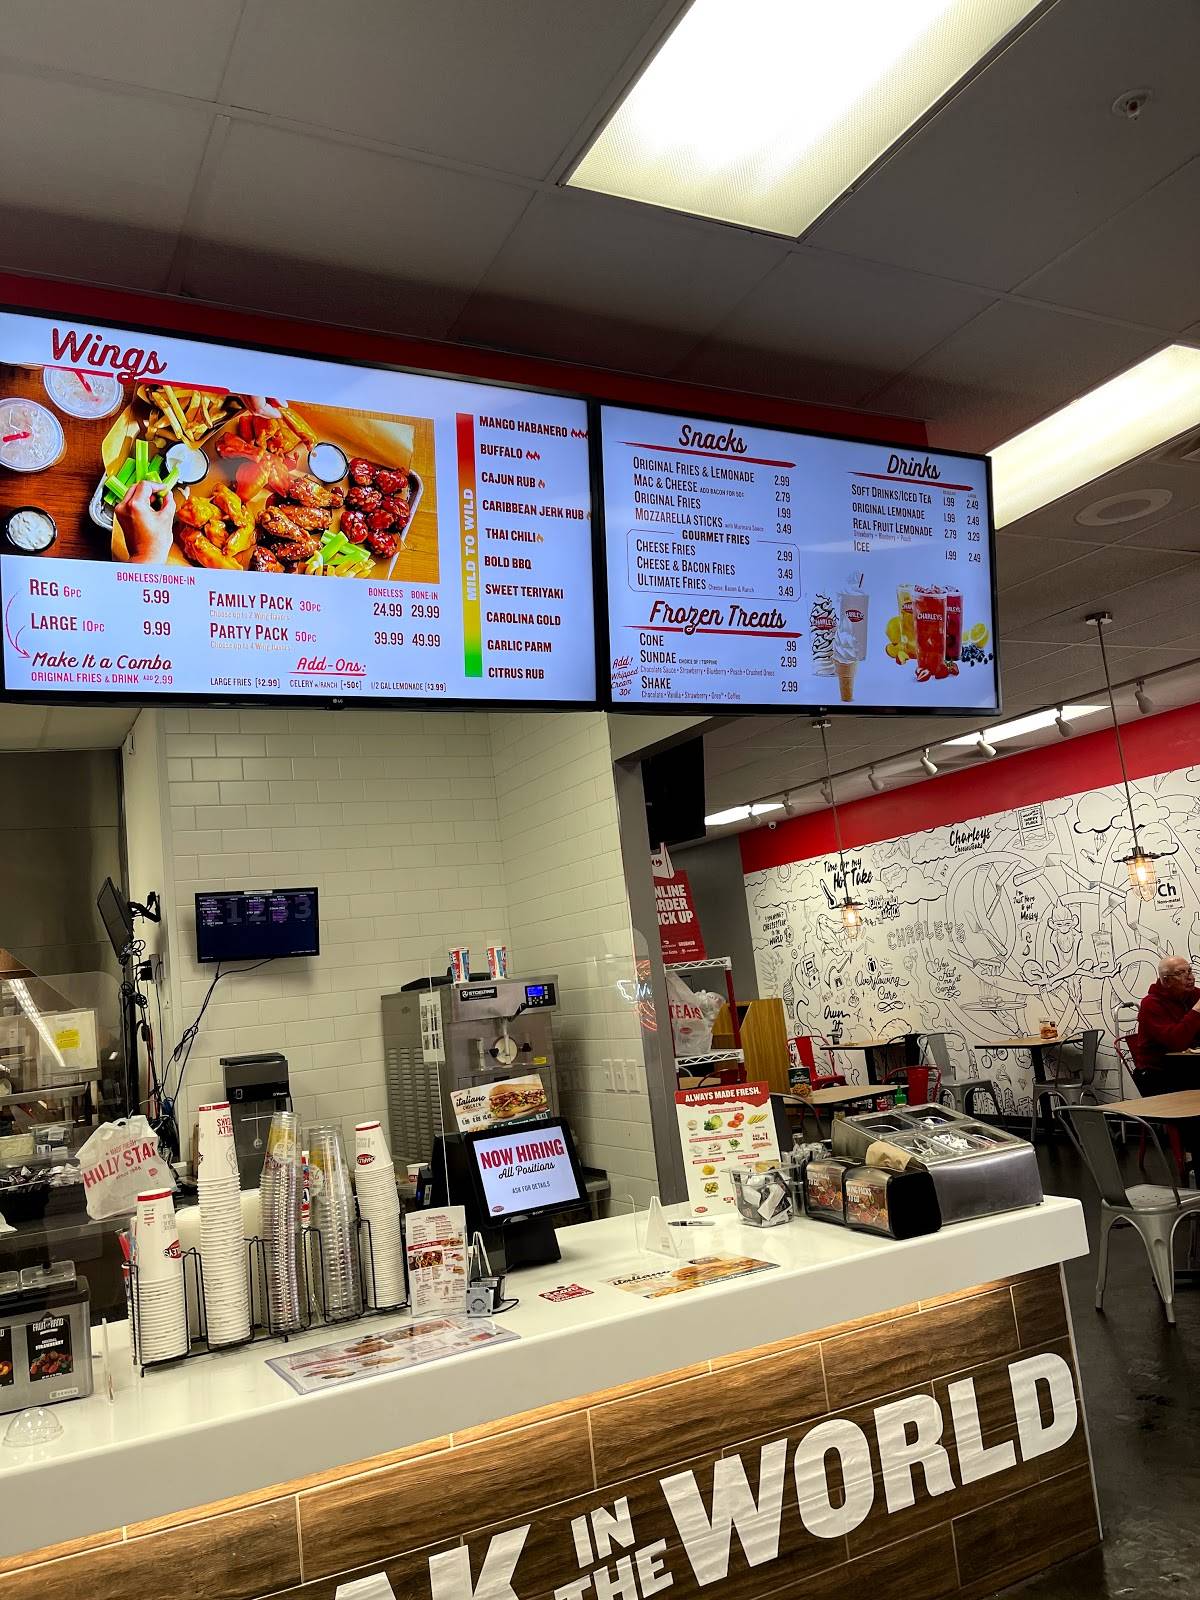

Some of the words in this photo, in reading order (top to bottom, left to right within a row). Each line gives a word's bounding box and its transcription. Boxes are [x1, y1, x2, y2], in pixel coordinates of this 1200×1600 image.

[52, 328, 167, 385] Wings
[479, 416, 515, 431] MANGO
[517, 421, 568, 437] HABANERO
[679, 424, 747, 454] Snacks
[480, 444, 522, 459] BUFFALO
[633, 456, 674, 473] ORIGINAL
[676, 462, 700, 476] FRIES
[702, 467, 708, 477] &
[711, 466, 754, 482] LEMONADE
[887, 455, 940, 479] Drinks
[481, 472, 514, 486] CAJUN
[517, 474, 536, 488] RUB
[634, 474, 654, 487] MAC
[656, 478, 663, 488] &
[666, 478, 698, 492] CHEESE
[774, 475, 790, 486] 2.99
[635, 491, 675, 507] ORIGINAL
[677, 494, 701, 509] FRIES
[775, 491, 790, 502] 2.79
[852, 484, 870, 497] SOFT
[872, 487, 918, 503] DRINKS/ICED
[919, 492, 932, 504] TEA
[944, 496, 955, 507] 1.99
[967, 500, 979, 510] 2.49
[464, 488, 474, 533] WILD
[482, 500, 537, 516] CARIBBEAN
[539, 503, 564, 517] JERK
[566, 506, 584, 520] RUB
[777, 507, 791, 518] 1.99
[853, 503, 885, 515] ORIGINAL
[888, 506, 925, 519] LEMONADE
[636, 508, 691, 525] MOZZARELLA
[694, 515, 723, 528] STICKS
[944, 513, 956, 523] 1.99
[967, 515, 979, 525] 2.49
[777, 523, 792, 534] 3.49
[853, 518, 870, 530] REAL
[873, 520, 893, 533] FRUIT
[895, 523, 932, 536] LEMONADE
[945, 529, 957, 539] 2.79
[485, 528, 508, 541] THAI
[511, 530, 536, 542] CHILI
[682, 530, 724, 543] GOURMET
[727, 532, 750, 545] FRIES
[968, 531, 980, 542] 3.29
[465, 536, 475, 556] TO
[636, 539, 670, 554] CHEESE
[672, 542, 696, 556] FRIES
[854, 541, 870, 552] ICEE
[777, 550, 792, 562] 2.99
[945, 550, 957, 560] 1.99
[968, 553, 980, 562] 2.49
[484, 556, 510, 568] BOLD
[512, 557, 532, 570] BBQ
[637, 556, 670, 571] CHEESE
[673, 562, 679, 571] &
[682, 561, 710, 574] BACON
[712, 562, 736, 575] FRIES
[117, 572, 195, 585] BONELESS/BONE-IN
[467, 560, 477, 601] MILD
[638, 573, 680, 588] ULTIMATE
[683, 577, 706, 590] FRIES
[778, 569, 793, 580] 3.49
[30, 579, 58, 596] REG
[64, 586, 81, 598] 6PC
[368, 588, 404, 598] BONELESS
[411, 591, 438, 600] BONE-IN
[485, 584, 518, 598] SWEET
[520, 586, 564, 599] TERIYAKI
[778, 586, 793, 596] 3.49
[143, 589, 170, 604] 5.99
[209, 590, 254, 608] FAMILY
[260, 594, 293, 610] PACK
[299, 601, 321, 612] 30PC
[373, 602, 402, 617] 24.99
[411, 604, 440, 619] 29.99
[917, 612, 943, 621] CHARLEYS
[31, 613, 77, 630] LARGE
[486, 612, 534, 625] CAROLINA
[536, 613, 561, 626] GOLD
[650, 600, 724, 635] Frozen
[727, 605, 786, 628] Treats
[144, 621, 170, 636] 9.99
[210, 622, 251, 640] PARTY
[256, 624, 288, 641] PACK
[295, 632, 317, 643] 50PC
[374, 632, 404, 646] 39.99
[412, 633, 441, 647] 49.99
[487, 640, 522, 652] GARLIC
[524, 641, 552, 652] PARM
[640, 633, 664, 647] CONE
[785, 641, 796, 652] .99
[32, 652, 78, 668] Make
[82, 654, 96, 668] It
[100, 658, 112, 669] a
[116, 654, 172, 670] Combo
[296, 656, 366, 672] Add-Ons:
[613, 657, 634, 668] Add!
[640, 650, 676, 664] SUNDAE
[781, 656, 797, 668] 2.99
[31, 672, 74, 682] ORIGINAL
[77, 673, 102, 683] FRIES
[112, 674, 139, 684] DRINK
[154, 675, 173, 684] 2.99
[488, 667, 524, 679] CITRUS
[526, 668, 544, 679] RUB
[210, 678, 231, 686] LARGE
[233, 679, 251, 687] FRIES
[290, 680, 313, 688] CELERY
[642, 676, 671, 689] SHAKE
[782, 681, 798, 692] 2.99
[950, 827, 991, 846] Charleys
[824, 861, 837, 872] Time
[852, 858, 861, 869] my
[851, 868, 873, 886] Take
[654, 885, 686, 898] NLINE
[1158, 883, 1176, 896] Ch
[656, 898, 688, 911] RDER
[657, 912, 677, 926] ICK
[678, 911, 693, 923] UP
[887, 921, 966, 949] CHARLEYS
[855, 970, 909, 990] Overflowing
[878, 986, 897, 1000] Care
[824, 1005, 850, 1019] Own
[456, 1096, 486, 1107] italiano
[685, 1092, 713, 1102] ALWAYS
[714, 1090, 735, 1099] MADE
[736, 1087, 761, 1096] FRESH.
[480, 1147, 513, 1169] NOW
[516, 1139, 565, 1163] HIRING
[83, 1155, 120, 1188] HILLY
[498, 1167, 514, 1179] All
[516, 1161, 555, 1176] Positions
[522, 1184, 531, 1192] FOR
[532, 1181, 550, 1191] DETAILS
[660, 1352, 1078, 1586] WORLD
[572, 1496, 634, 1568] IN
